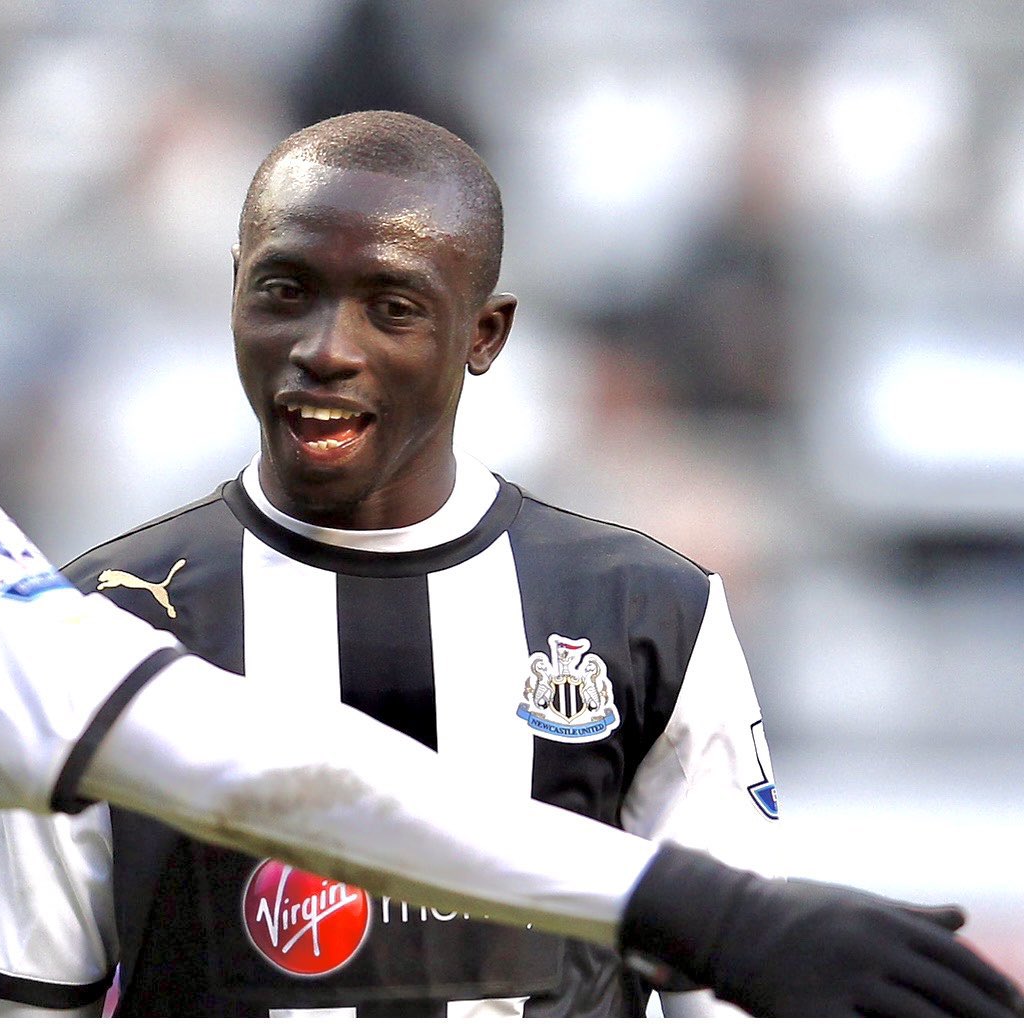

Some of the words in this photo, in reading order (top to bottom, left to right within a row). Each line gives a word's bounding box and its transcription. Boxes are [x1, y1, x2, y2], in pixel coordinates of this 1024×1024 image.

[531, 718, 578, 736] NEWCASTLE
[578, 723, 605, 735] UNITED
[256, 865, 358, 957] Virgin
